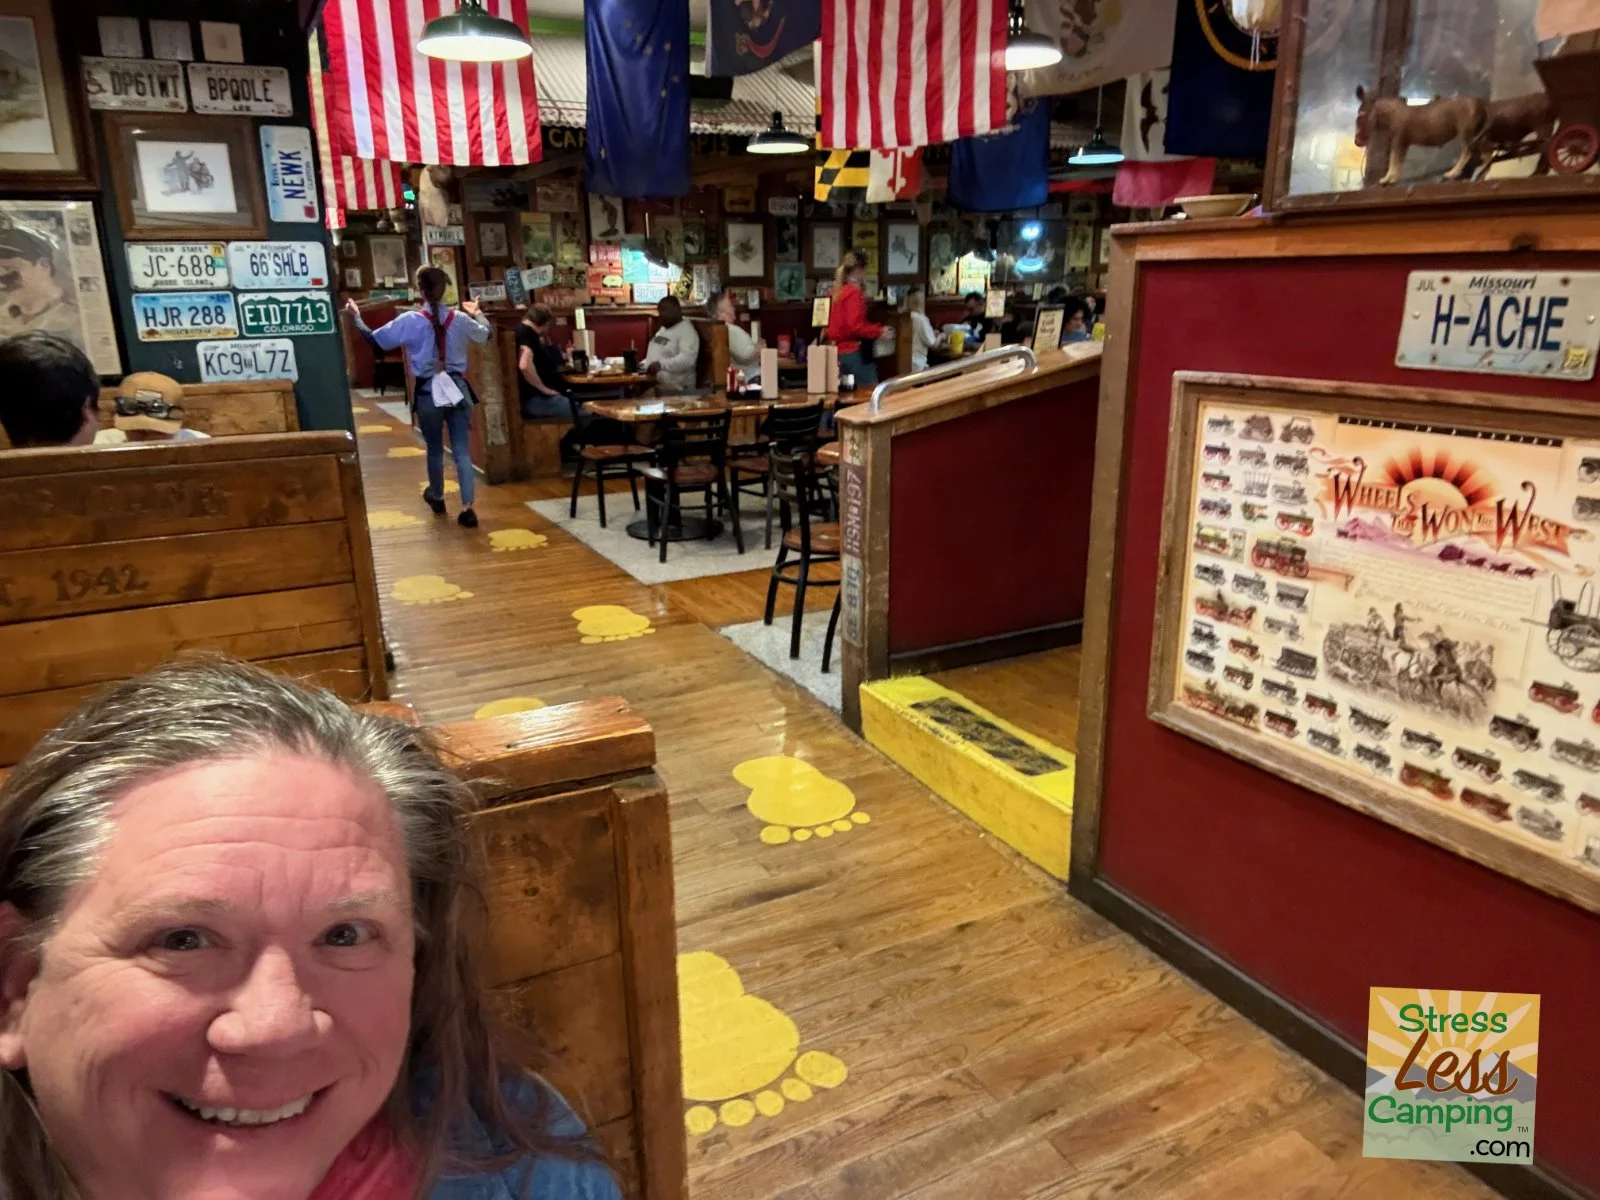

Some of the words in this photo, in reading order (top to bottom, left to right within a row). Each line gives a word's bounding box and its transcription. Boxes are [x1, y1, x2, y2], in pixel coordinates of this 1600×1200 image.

[278, 150, 307, 199] NEWK
[143, 255, 216, 277] JC-688
[1416, 279, 1436, 291] JUL
[1468, 275, 1538, 289] Missouri
[143, 306, 182, 327] HJR
[188, 305, 226, 326] 288
[244, 302, 328, 326] EID7713
[1430, 294, 1569, 351] H-ACHE
[263, 324, 315, 333] COLORADO
[203, 352, 244, 376] KC9
[51, 563, 149, 602] 1942
